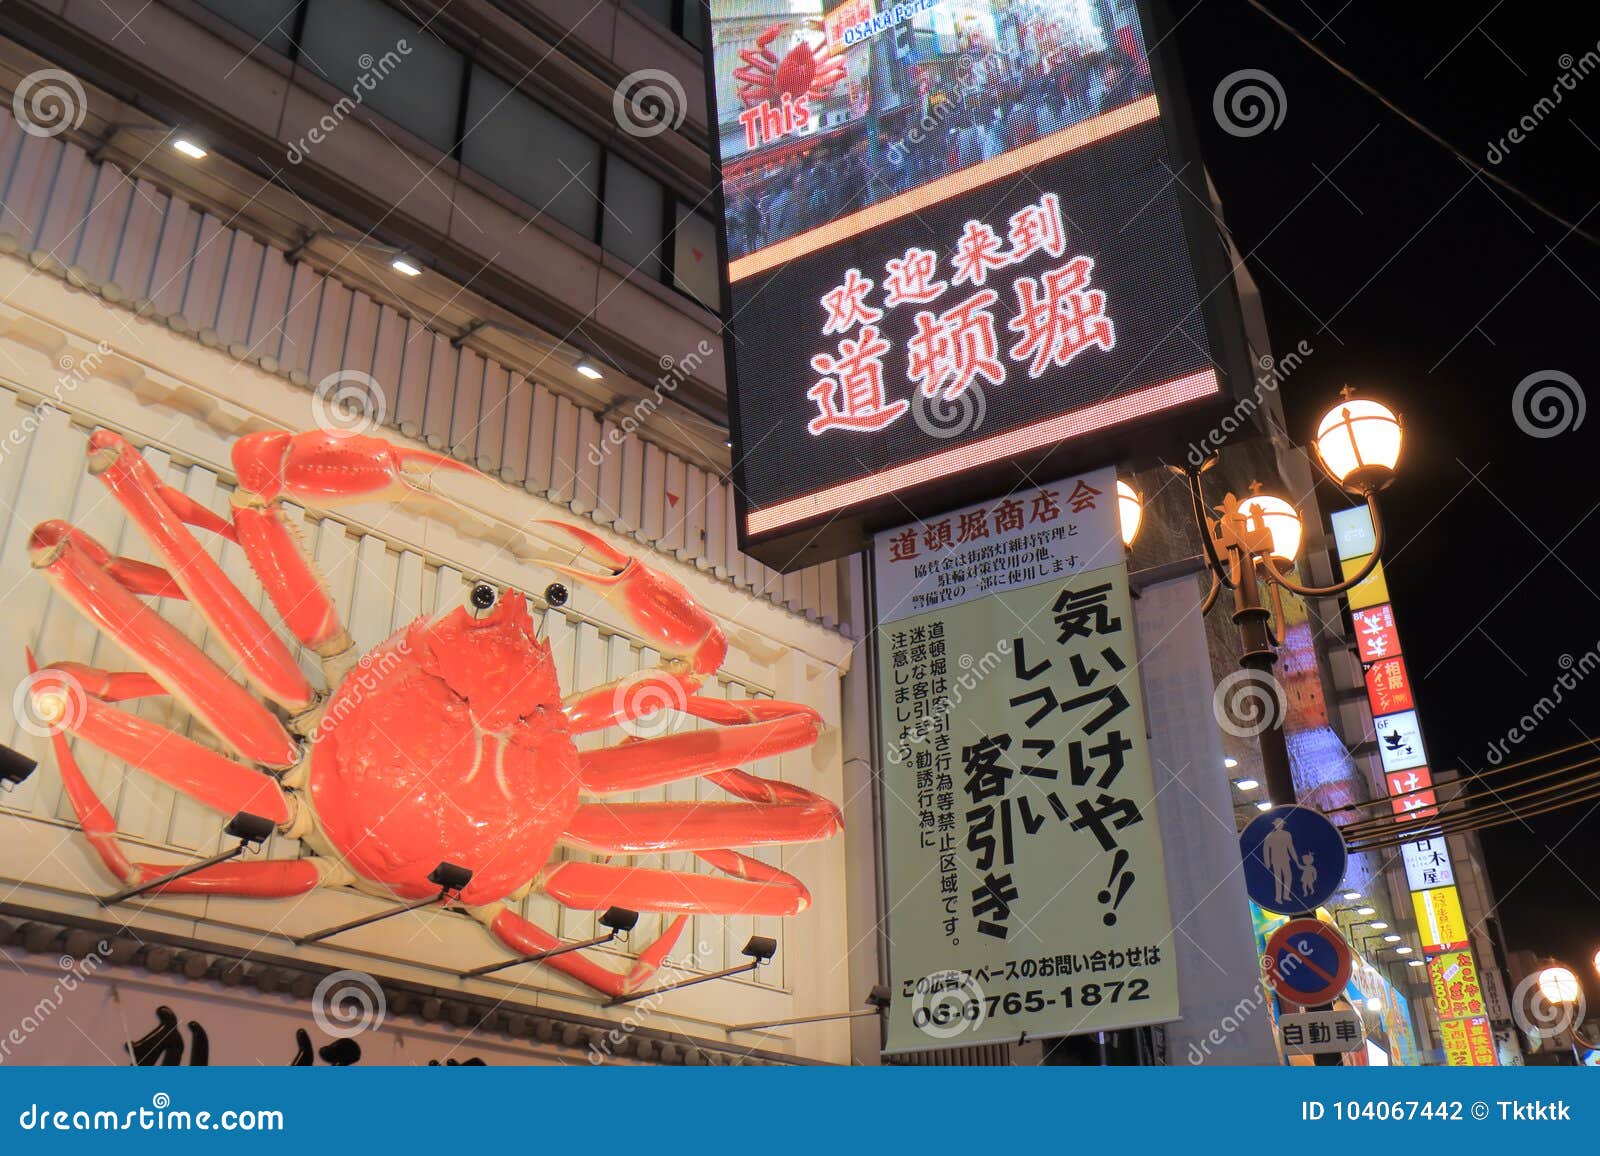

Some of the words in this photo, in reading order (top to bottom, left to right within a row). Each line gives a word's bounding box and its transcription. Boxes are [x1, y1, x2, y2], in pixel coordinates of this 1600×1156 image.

[739, 93, 811, 149] This
[820, 191, 1066, 335] 欢迎来到
[807, 256, 1117, 436] 道顿堀
[889, 480, 1103, 563] 道頓堀商店会
[1377, 720, 1389, 729] 6F
[961, 733, 1019, 939] 客引き
[912, 978, 1151, 1028] 06-6765-1872
[1283, 1020, 1359, 1046] 自動車
